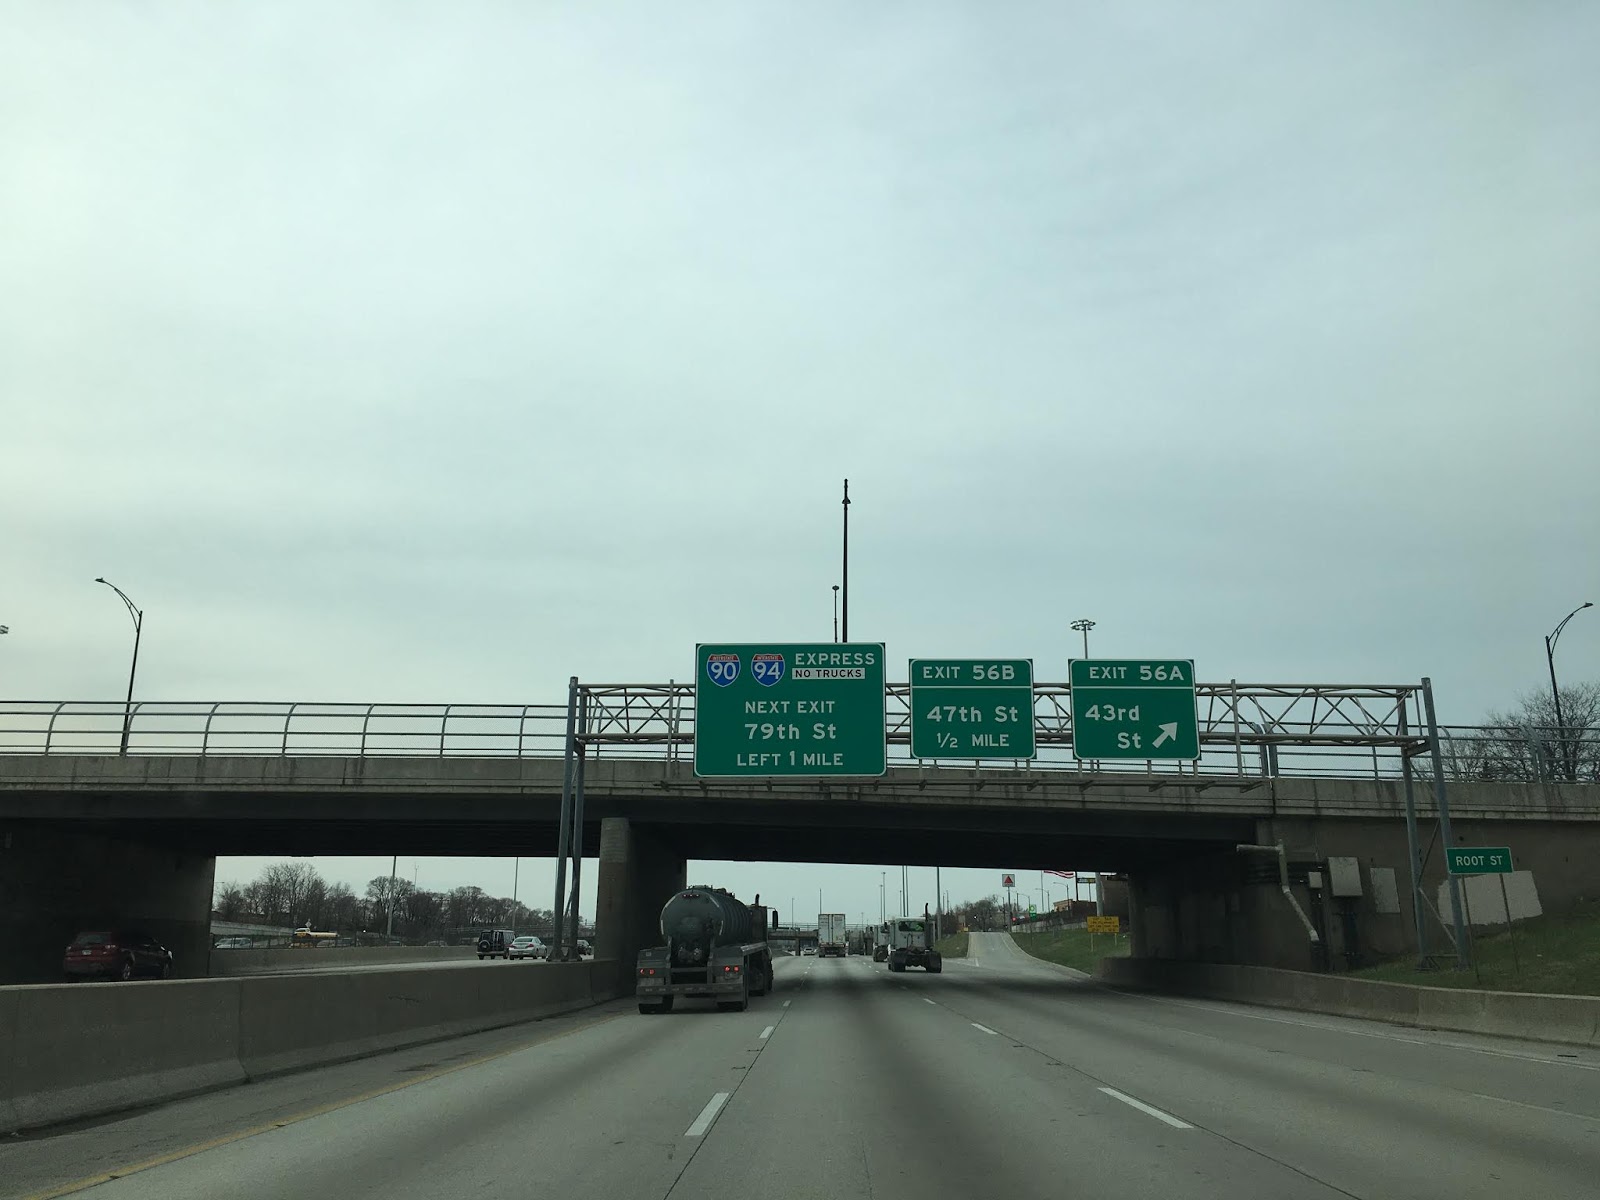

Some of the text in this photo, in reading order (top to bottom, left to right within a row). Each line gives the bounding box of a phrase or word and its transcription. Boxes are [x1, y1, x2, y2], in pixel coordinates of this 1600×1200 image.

[795, 653, 875, 665] EXPRESS
[710, 662, 737, 680] 90
[754, 662, 781, 680] 94
[795, 669, 862, 678] NO TRUCKS
[923, 664, 1015, 680] EXIT 56B
[1089, 665, 1184, 681] EXIT 56A
[745, 701, 836, 714] NEXT EXIT
[926, 705, 1019, 723] 47th St
[1085, 704, 1140, 721] 43rd
[744, 723, 837, 740] 79th St
[971, 734, 1010, 747] MILE
[1117, 732, 1142, 749] St
[737, 750, 844, 767] LEFT 1 MILE
[1455, 855, 1503, 866] ROOT ST
